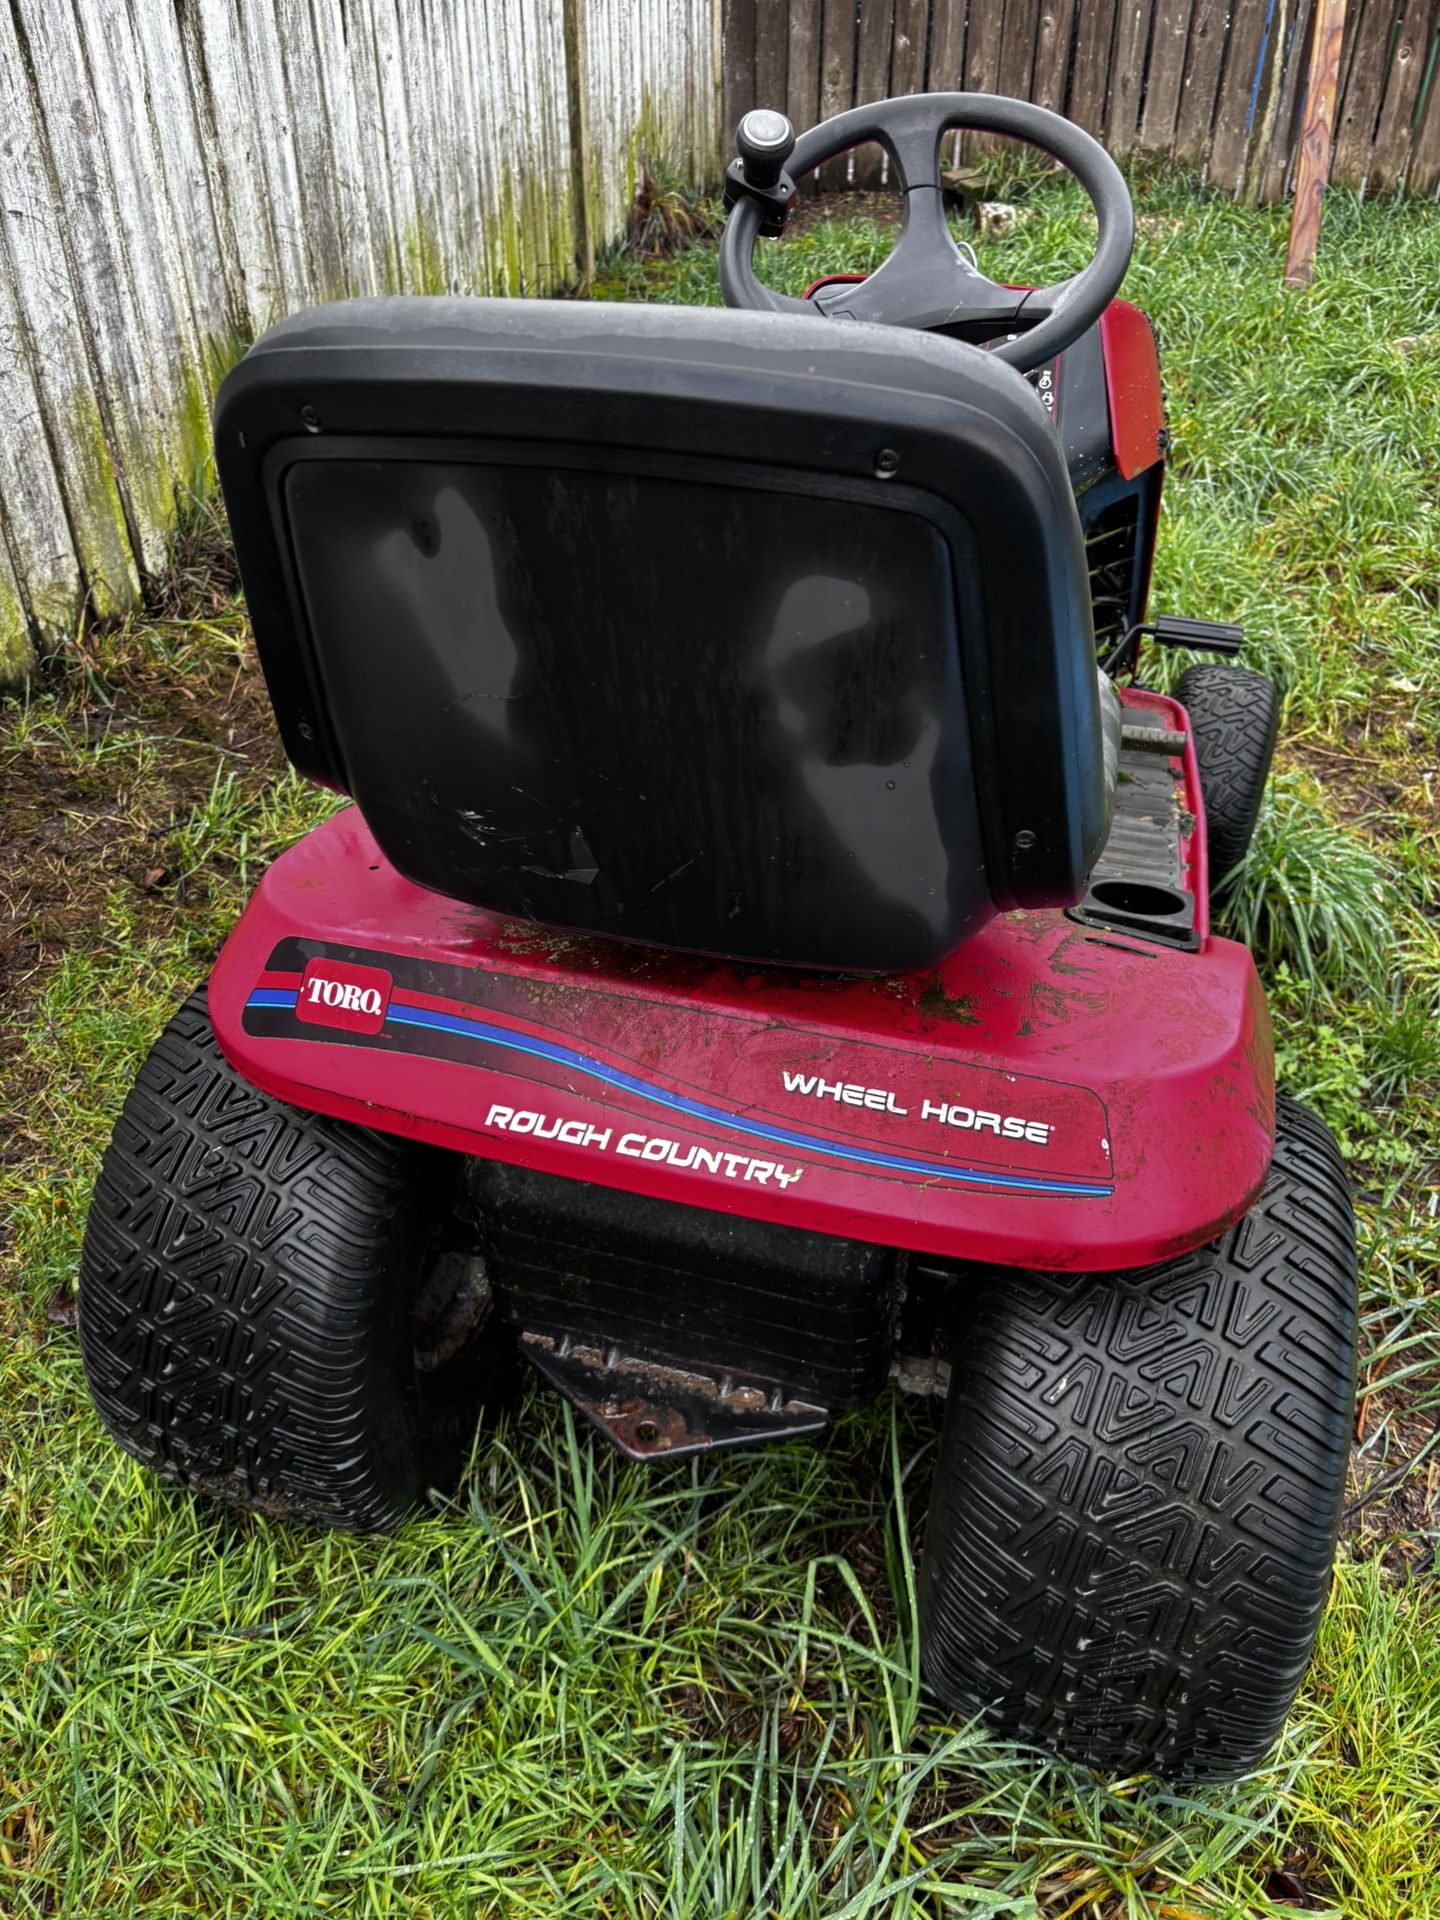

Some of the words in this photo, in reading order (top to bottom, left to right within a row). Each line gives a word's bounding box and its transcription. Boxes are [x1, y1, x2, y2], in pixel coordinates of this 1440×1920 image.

[783, 1071, 908, 1115] WHEEL
[484, 1104, 613, 1150] ROUGH
[615, 1132, 804, 1189] COUNTRY
